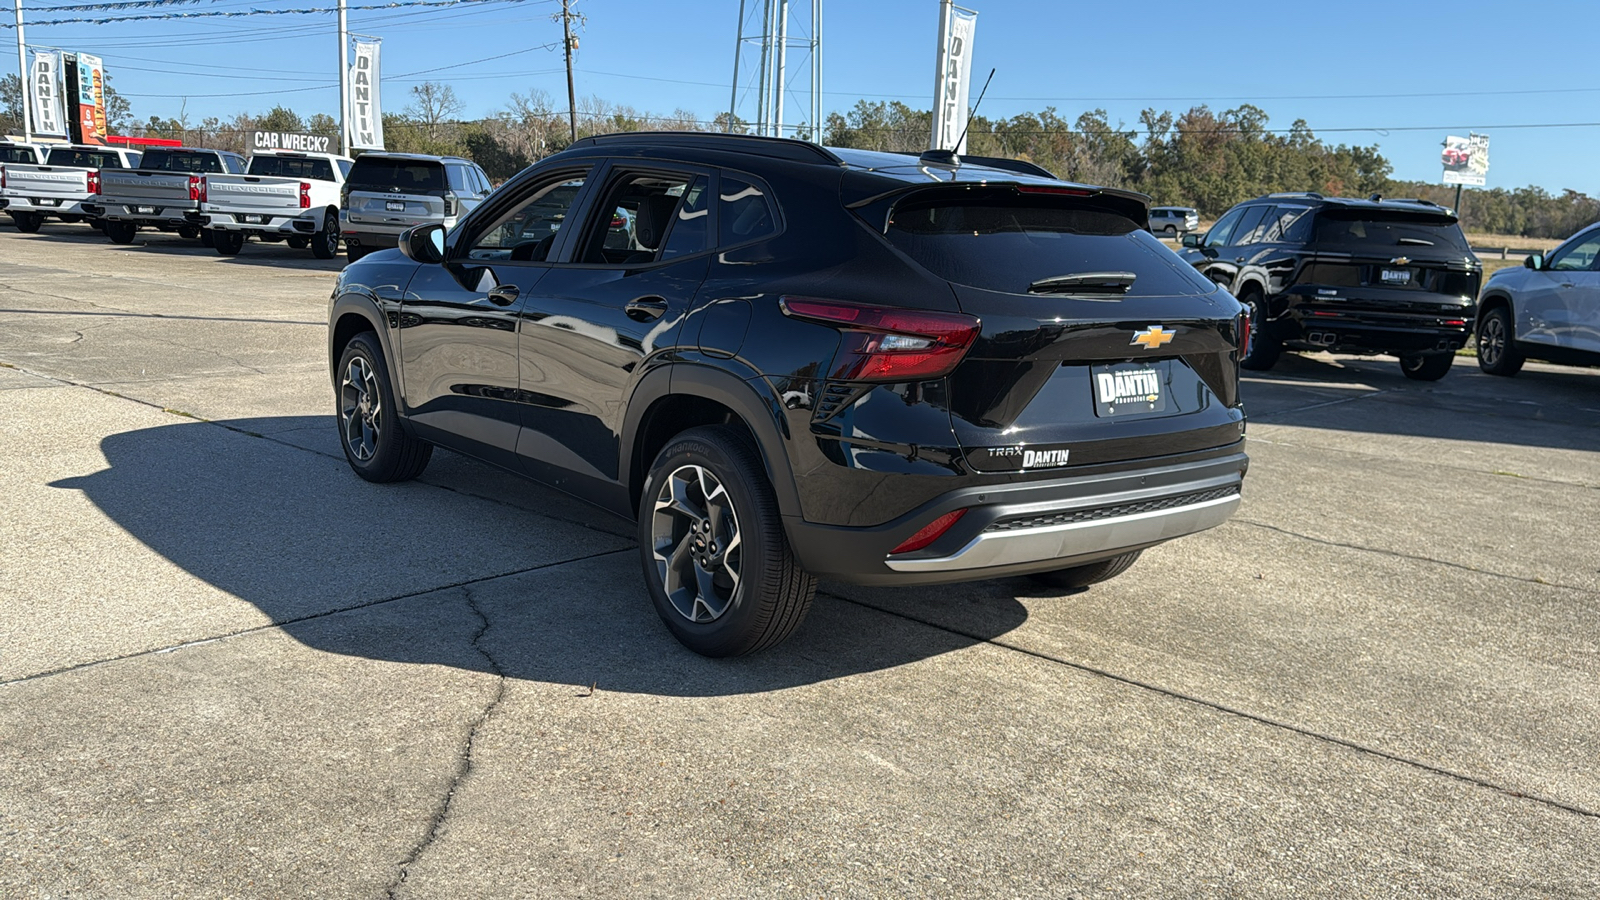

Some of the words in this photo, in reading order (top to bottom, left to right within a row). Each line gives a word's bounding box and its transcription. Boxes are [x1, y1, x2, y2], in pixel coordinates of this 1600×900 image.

[38, 61, 55, 132] DANTIN
[355, 55, 374, 145] DANTIN
[945, 36, 963, 151] DANTI
[254, 131, 279, 148] CAR
[281, 132, 329, 152] WRECK?
[211, 184, 295, 195] CHEVROLET
[1381, 270, 1411, 280] DANTIN
[1098, 373, 1159, 403] DANTIN
[988, 446, 1023, 457] TRAX
[1022, 449, 1070, 468] DANTIN
